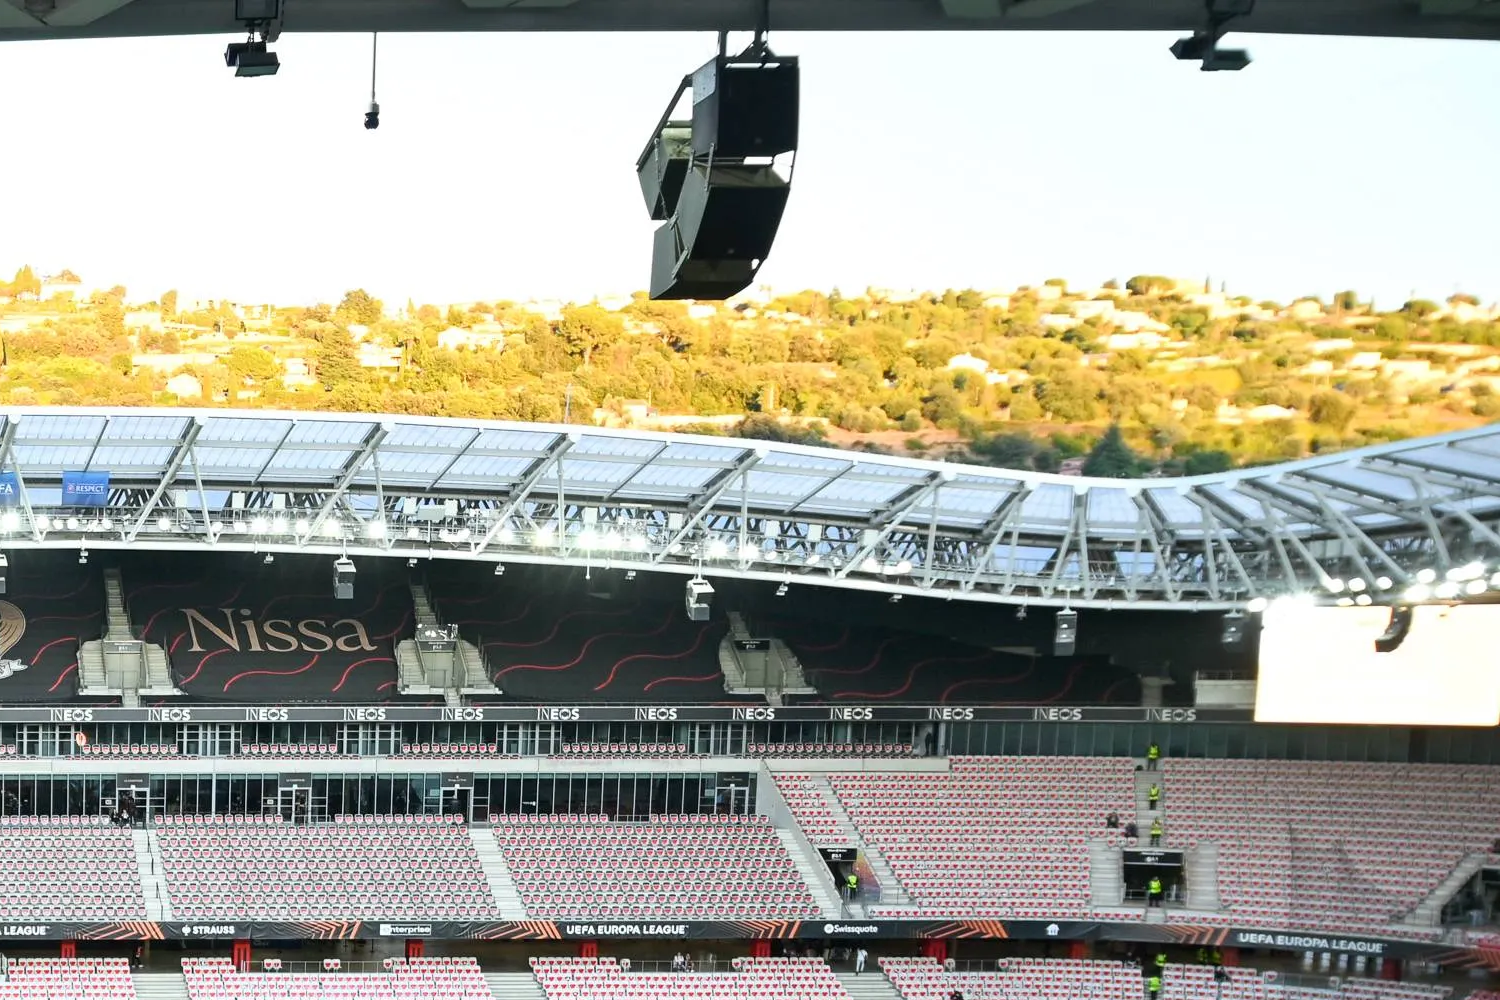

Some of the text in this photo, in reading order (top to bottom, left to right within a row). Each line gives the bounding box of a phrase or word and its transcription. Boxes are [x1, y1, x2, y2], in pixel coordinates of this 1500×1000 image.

[181, 608, 377, 652] Nissa
[50, 708, 93, 722] INEOS
[148, 708, 189, 722] INEOS
[246, 708, 288, 722] INEOS
[343, 708, 386, 722] INEOS
[441, 708, 484, 722] INEOS
[537, 707, 580, 721] INEOS
[635, 707, 677, 721] INEOS
[732, 707, 775, 721] INEOS
[830, 707, 873, 721] INEOS
[929, 707, 974, 721] INEOS
[1034, 707, 1082, 721] INEOS
[1146, 707, 1196, 721] INEOS
[193, 926, 235, 934] STRAUSS
[567, 925, 595, 935] UEFA
[598, 925, 640, 935] EUROPA
[834, 923, 878, 935] Swissquote
[1238, 932, 1273, 944] UEFA
[1276, 935, 1328, 948] EUROPA
